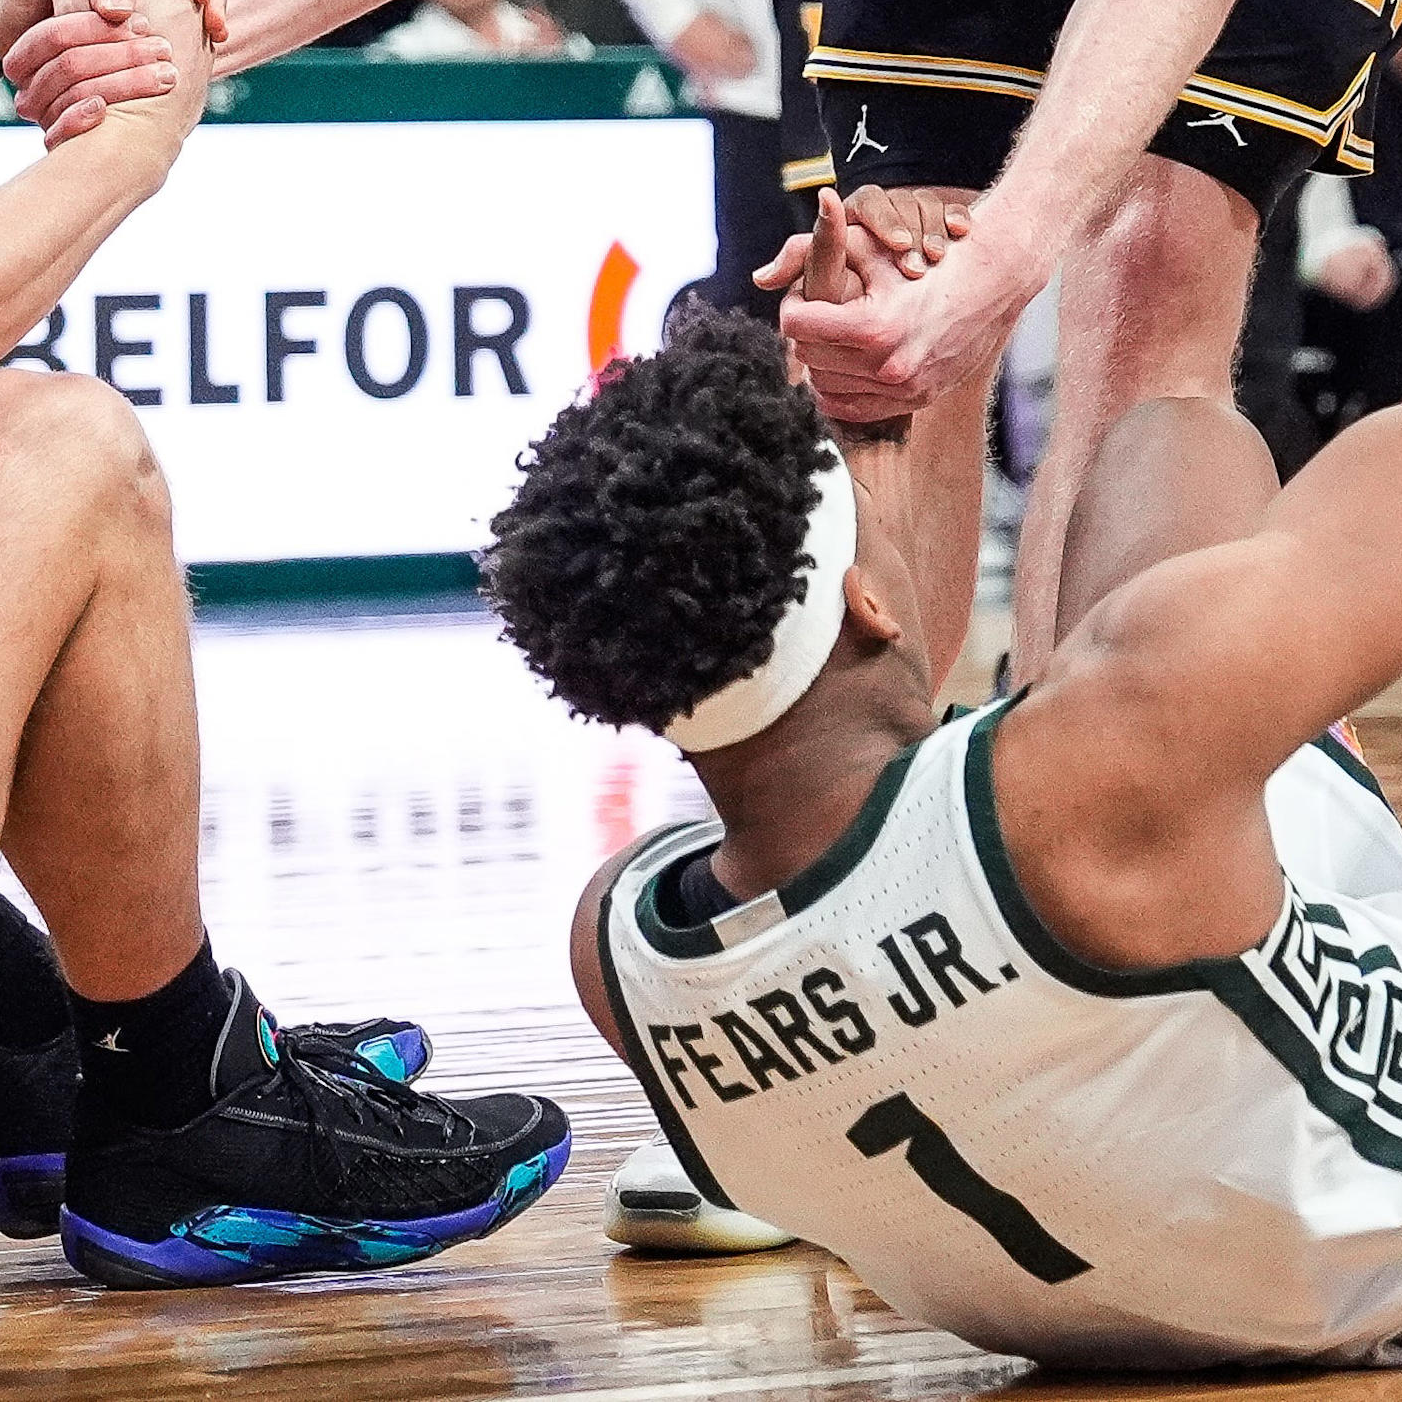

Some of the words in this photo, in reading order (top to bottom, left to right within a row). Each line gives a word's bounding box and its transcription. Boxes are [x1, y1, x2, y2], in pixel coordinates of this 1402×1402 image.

[647, 966, 877, 1110] FEARS
[876, 910, 1022, 1029] JR.
[845, 1091, 1096, 1285] 1
